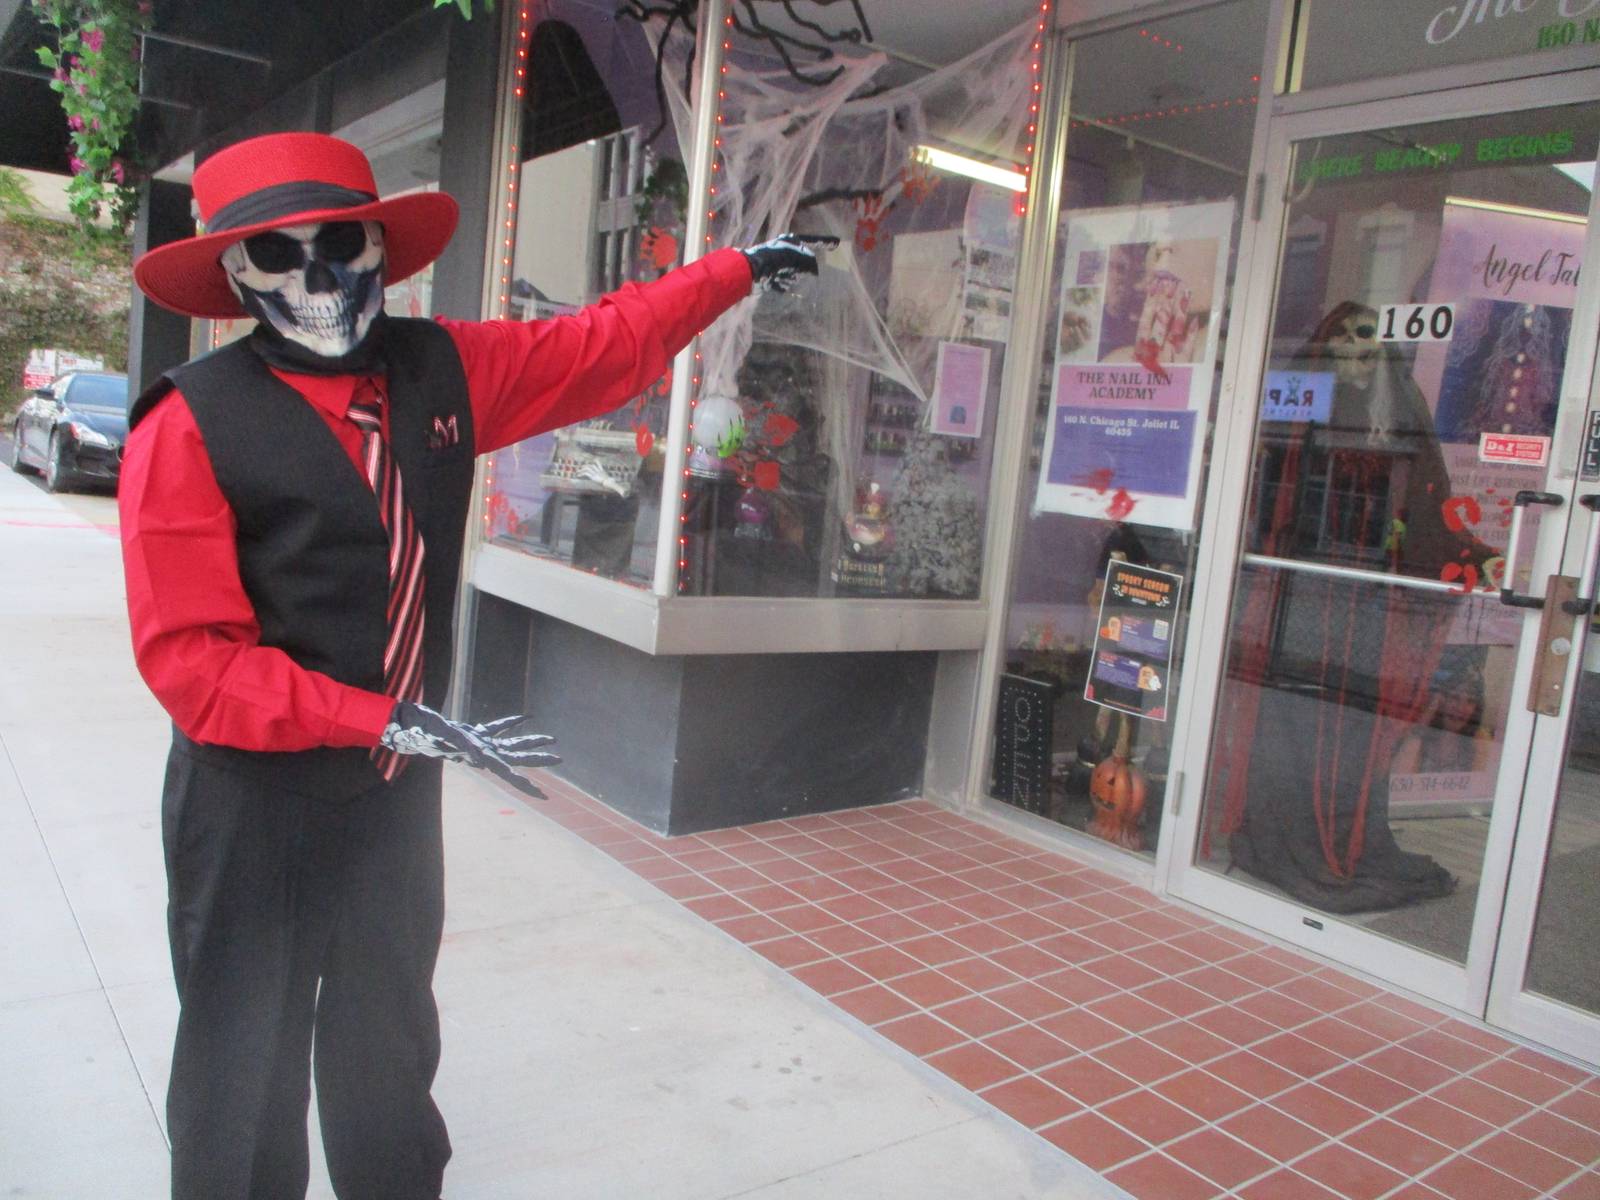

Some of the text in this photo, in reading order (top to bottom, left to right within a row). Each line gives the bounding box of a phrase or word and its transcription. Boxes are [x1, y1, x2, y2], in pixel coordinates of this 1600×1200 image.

[1477, 131, 1574, 162] BEGINS
[1472, 244, 1552, 296] Angel
[1383, 305, 1453, 339] 160
[1077, 371, 1173, 386] THE NAIL INN
[1089, 387, 1157, 400] ACADEMY
[1089, 415, 1125, 427] Chicago
[1142, 418, 1167, 429] Joliet
[1012, 697, 1031, 808] OPEN
